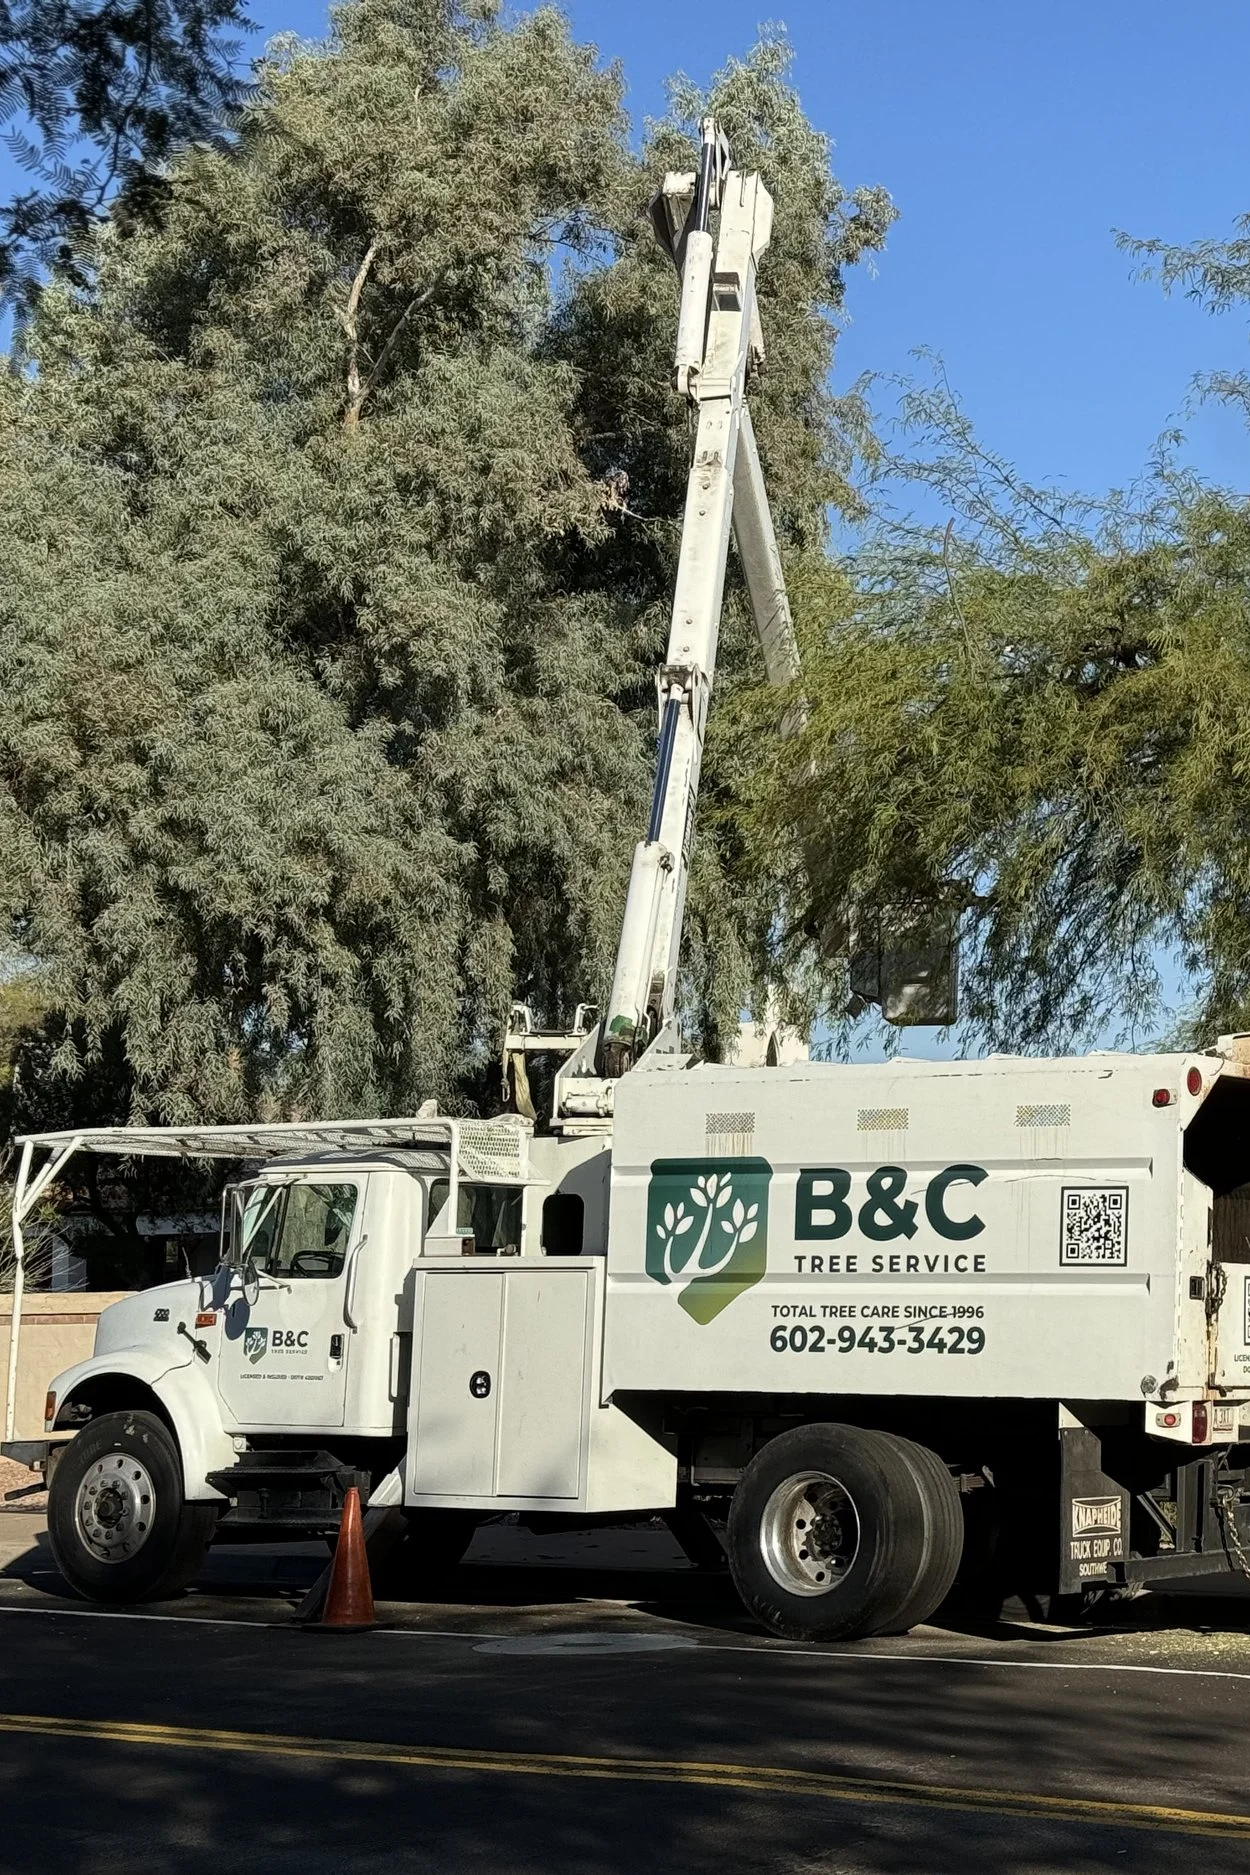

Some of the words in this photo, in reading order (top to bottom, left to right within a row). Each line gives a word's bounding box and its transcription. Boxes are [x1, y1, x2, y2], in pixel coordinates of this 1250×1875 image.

[794, 1164, 989, 1242] B&C
[794, 1255, 858, 1273] TREE
[871, 1254, 986, 1273] SERVICE
[771, 1305, 817, 1318] TOTAL
[821, 1305, 857, 1318] TREE
[860, 1305, 900, 1318] CARE
[903, 1305, 948, 1319] SINCE
[952, 1305, 985, 1319] 1996
[271, 1330, 309, 1348] B&C
[769, 1325, 986, 1355] 602-943-3429
[1072, 1501, 1122, 1532] KNAPHEIDE
[1070, 1540, 1092, 1560] TRUCK
[1079, 1561, 1108, 1577] SOUTHWE
